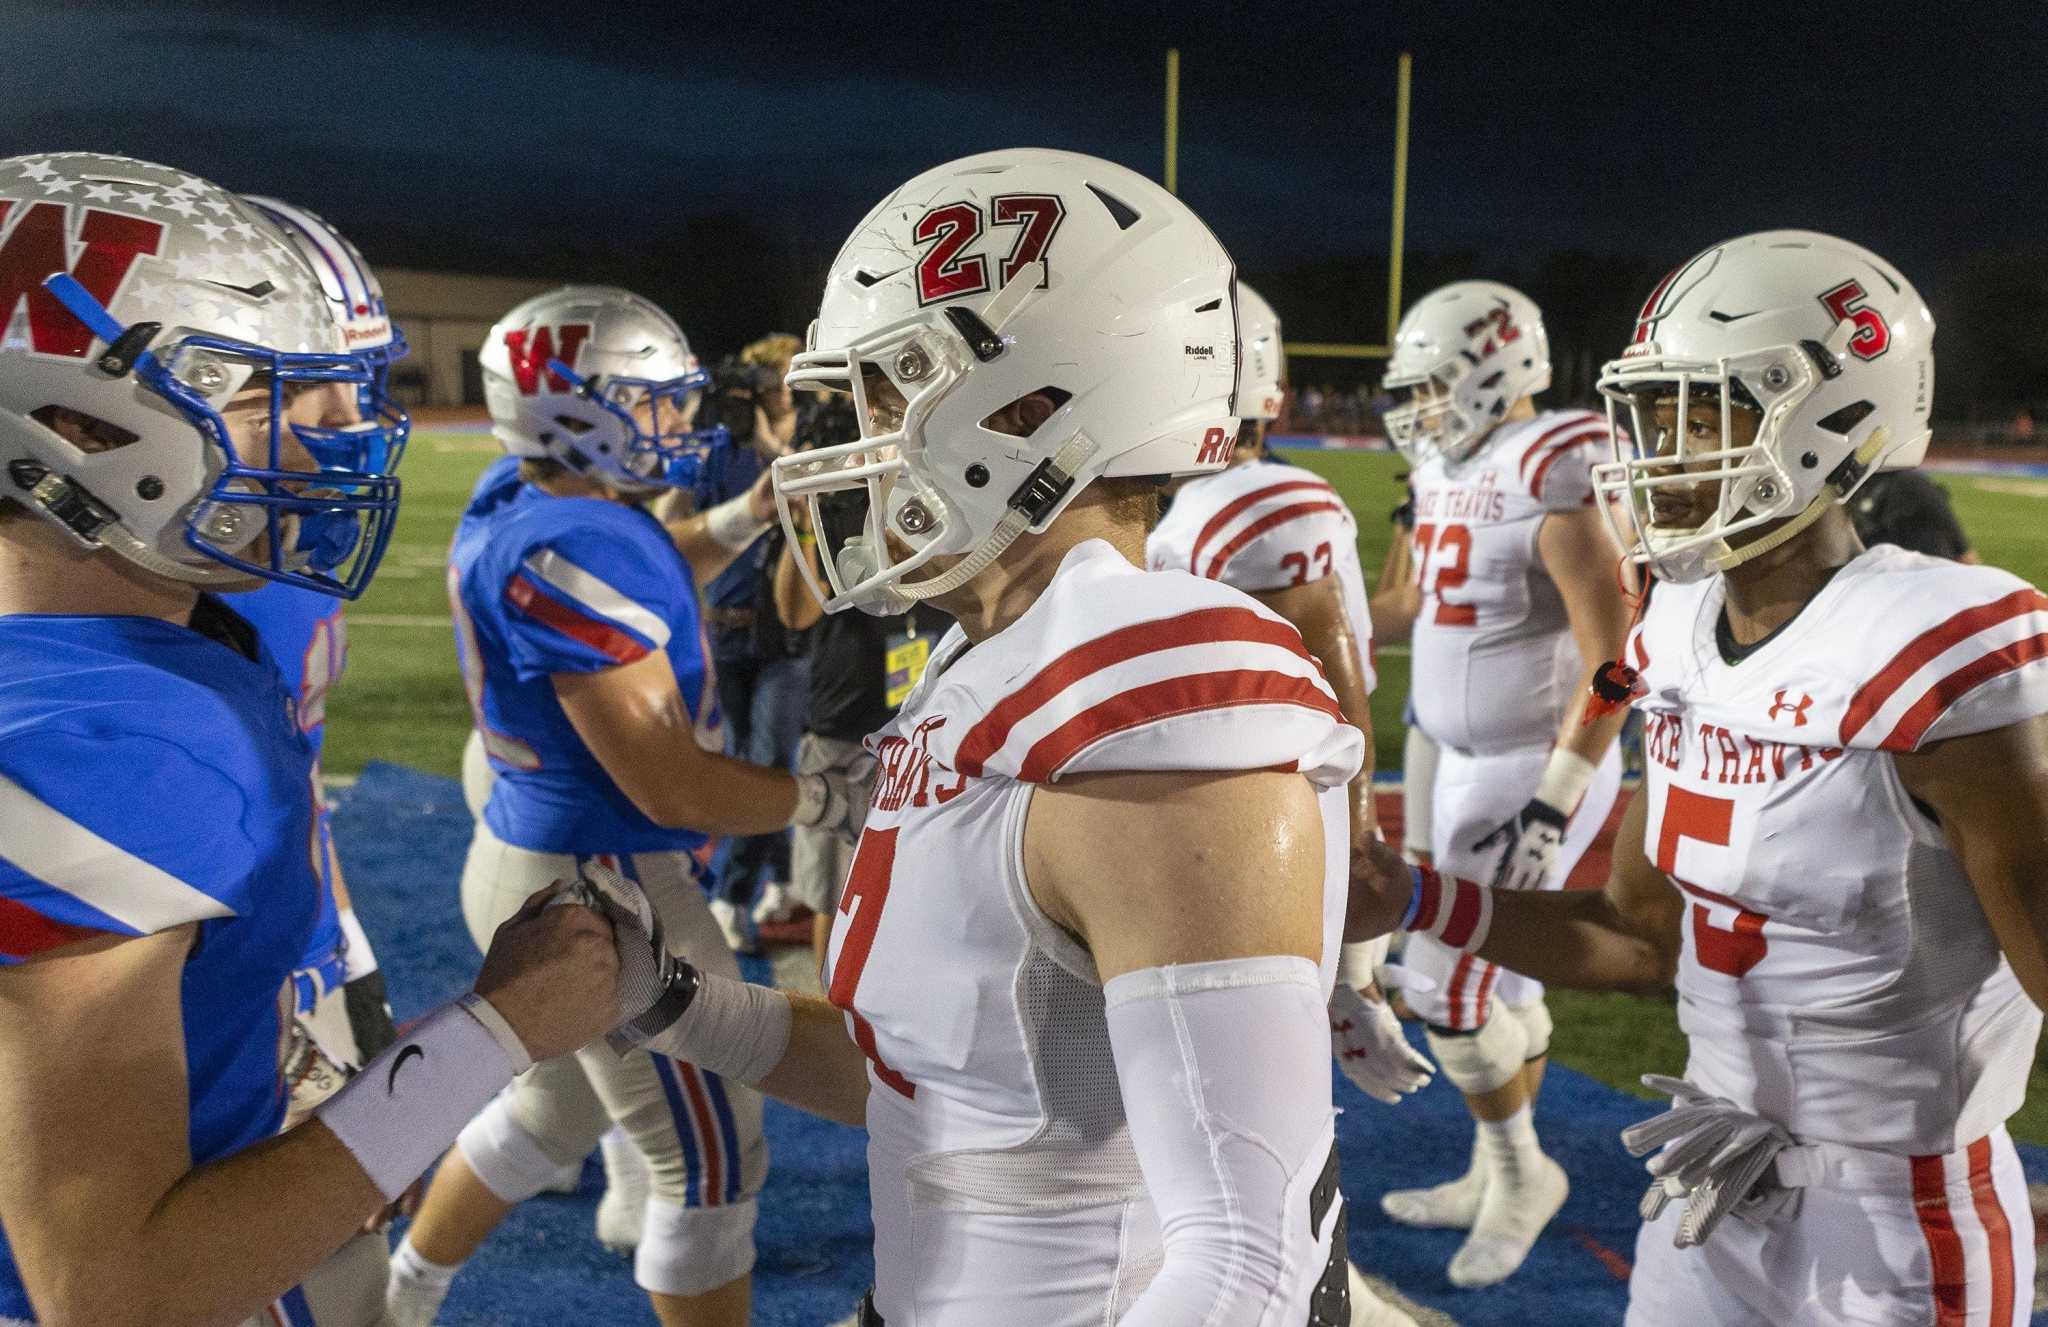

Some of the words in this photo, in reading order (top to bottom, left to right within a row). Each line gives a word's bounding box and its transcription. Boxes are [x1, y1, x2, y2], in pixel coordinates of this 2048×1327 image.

[0, 199, 171, 363] W
[913, 194, 1067, 308] 27
[504, 322, 594, 398] W
[1185, 345, 1214, 355] Riddell
[1817, 278, 1891, 362] 5
[1415, 523, 1477, 627] 72
[1657, 783, 1770, 978] 5
